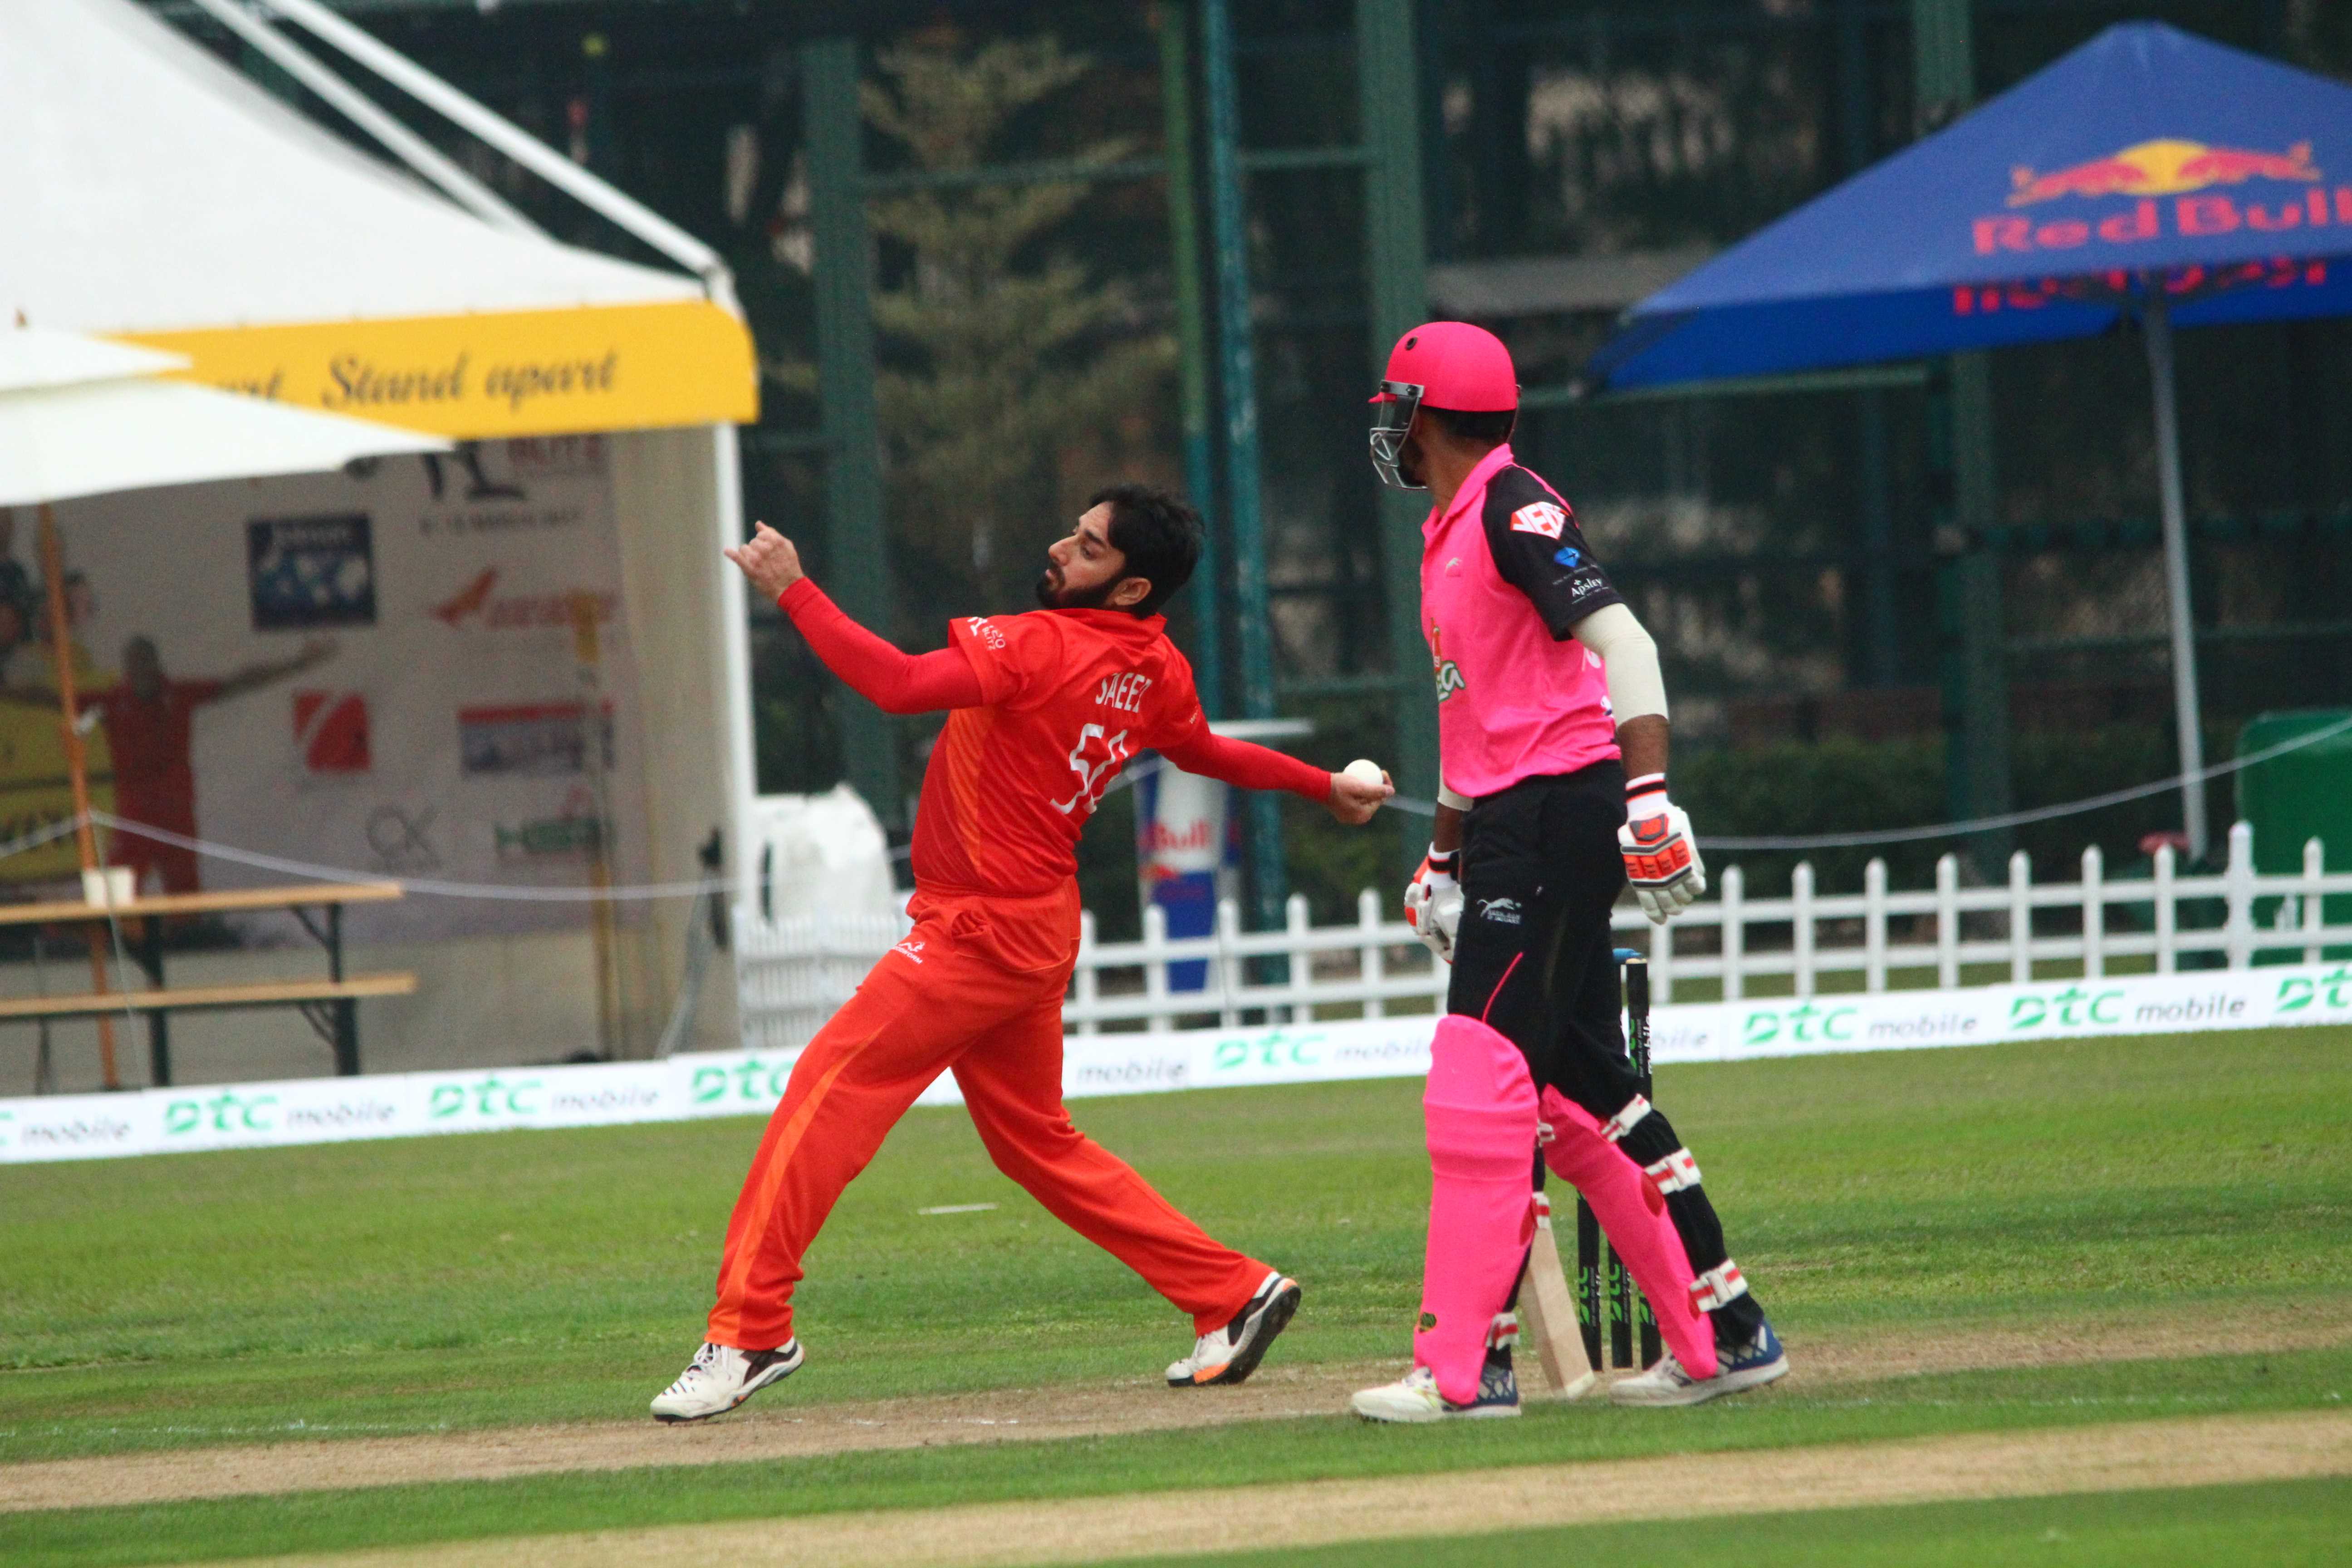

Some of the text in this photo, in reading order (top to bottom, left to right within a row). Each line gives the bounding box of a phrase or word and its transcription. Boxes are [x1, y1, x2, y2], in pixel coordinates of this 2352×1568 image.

[1972, 185, 2352, 256] Red Bull
[321, 351, 468, 409] Stand
[485, 348, 618, 414] apart
[1571, 578, 1603, 598] Apsley
[981, 626, 996, 650] BLITZ
[2135, 995, 2245, 1024] mobile
[1651, 1025, 1708, 1050] bile
[1867, 1012, 1978, 1039] mobile
[1077, 1056, 1188, 1084] mobile
[551, 1083, 660, 1111] mobile
[286, 1100, 397, 1126] mobile
[21, 1117, 132, 1146] mobile
